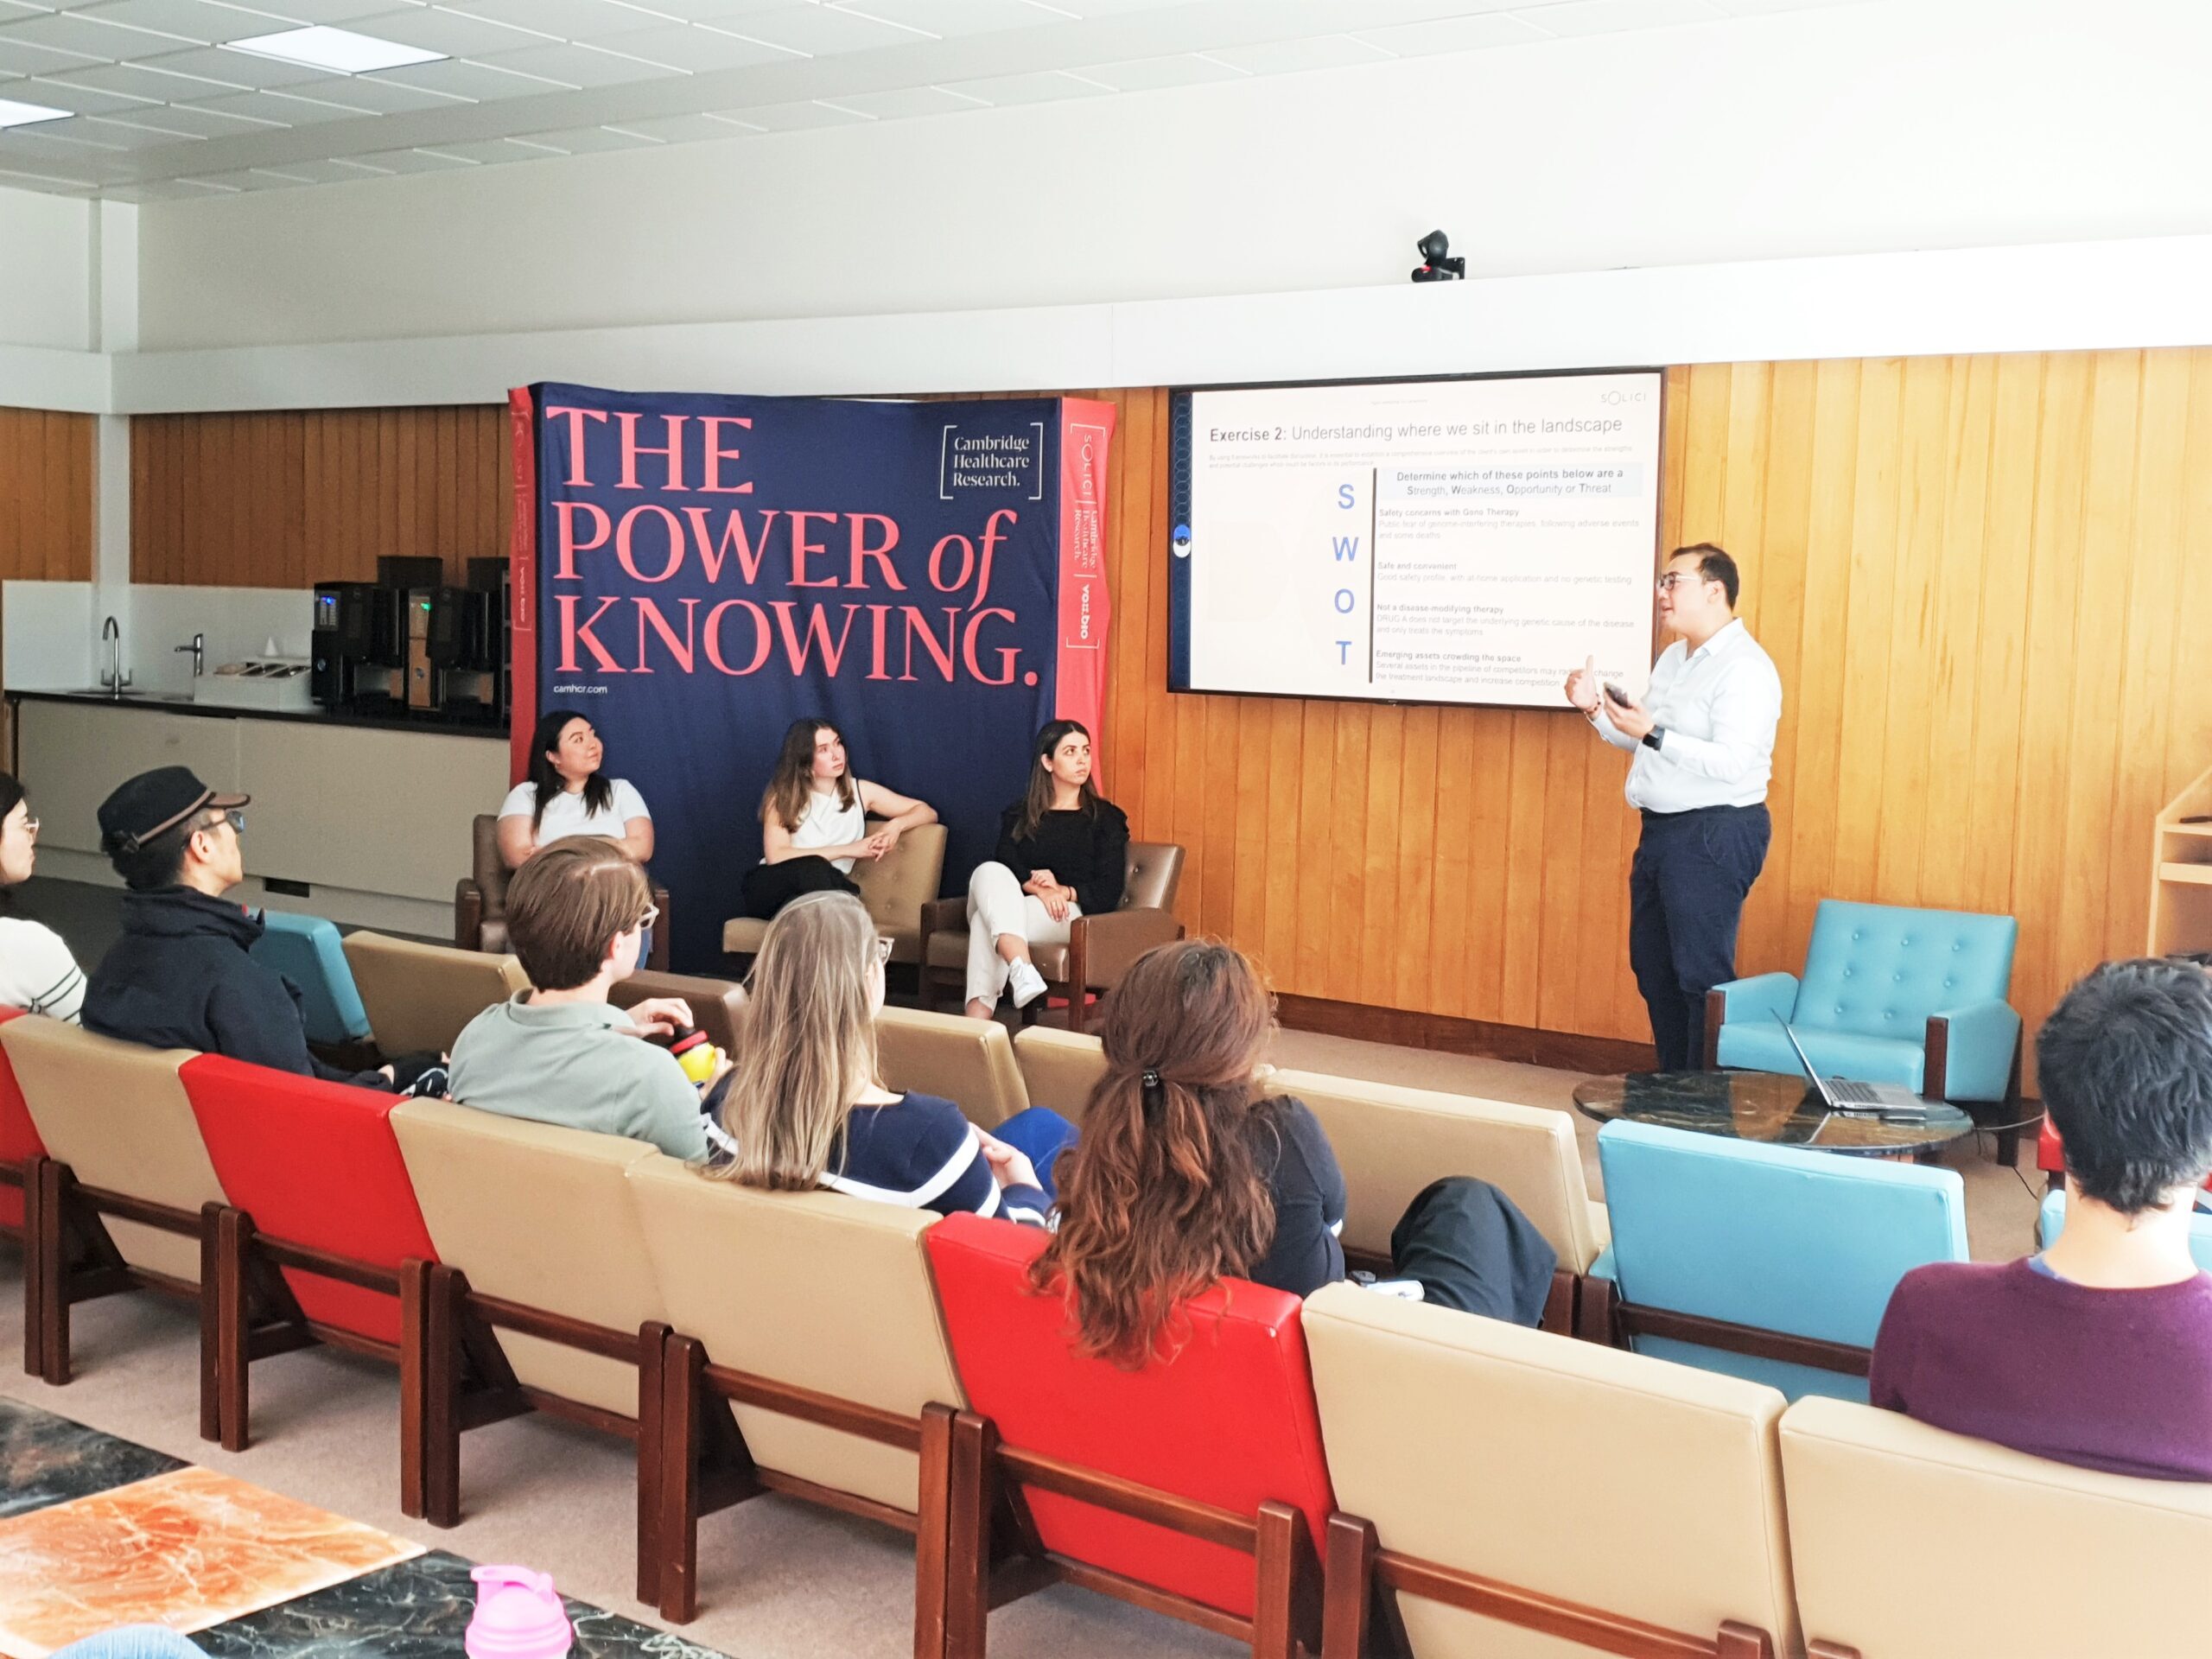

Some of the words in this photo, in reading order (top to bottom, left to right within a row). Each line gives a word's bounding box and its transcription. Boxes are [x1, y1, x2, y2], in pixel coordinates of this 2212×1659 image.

[1211, 428, 1269, 442] Exercise
[1274, 427, 1286, 441] 2:
[1293, 424, 1392, 441] Understanding
[1398, 423, 1441, 436] where
[1446, 425, 1467, 435] we
[1473, 421, 1489, 435] sit
[1495, 421, 1506, 434] in
[1513, 420, 1535, 434] the
[1541, 418, 1622, 435] landscape
[546, 406, 753, 493] THE
[954, 435, 1030, 451] Cambridge
[954, 454, 1030, 468] Healthcare
[954, 471, 1020, 486] Research.
[1397, 472, 1446, 481] Determine
[1450, 471, 1479, 480] which
[1482, 470, 1492, 480] of
[1496, 471, 1522, 480] these
[1526, 470, 1559, 481] points
[1562, 469, 1593, 478] below
[1338, 484, 1355, 509] S
[1407, 486, 1448, 497] Strength,
[1452, 485, 1503, 495] Weakness,
[1506, 484, 1562, 496] Opportunity
[1579, 483, 1611, 493] Threat
[1379, 509, 1403, 519] Safety
[1486, 508, 1519, 519] Therapy
[551, 501, 907, 590] POWER
[929, 509, 1017, 612] of
[1332, 537, 1359, 562] W
[1378, 562, 1395, 570] Safe
[1334, 588, 1355, 613] O
[1473, 605, 1503, 616] therapy
[554, 594, 1038, 686] KNOWING.
[1336, 641, 1352, 665] T
[1376, 651, 1413, 663] Emerging
[1415, 652, 1440, 660] assets
[1443, 652, 1479, 664] crowding
[1482, 653, 1494, 662] the
[1497, 656, 1521, 665] space
[554, 684, 607, 694] camhcr.com
